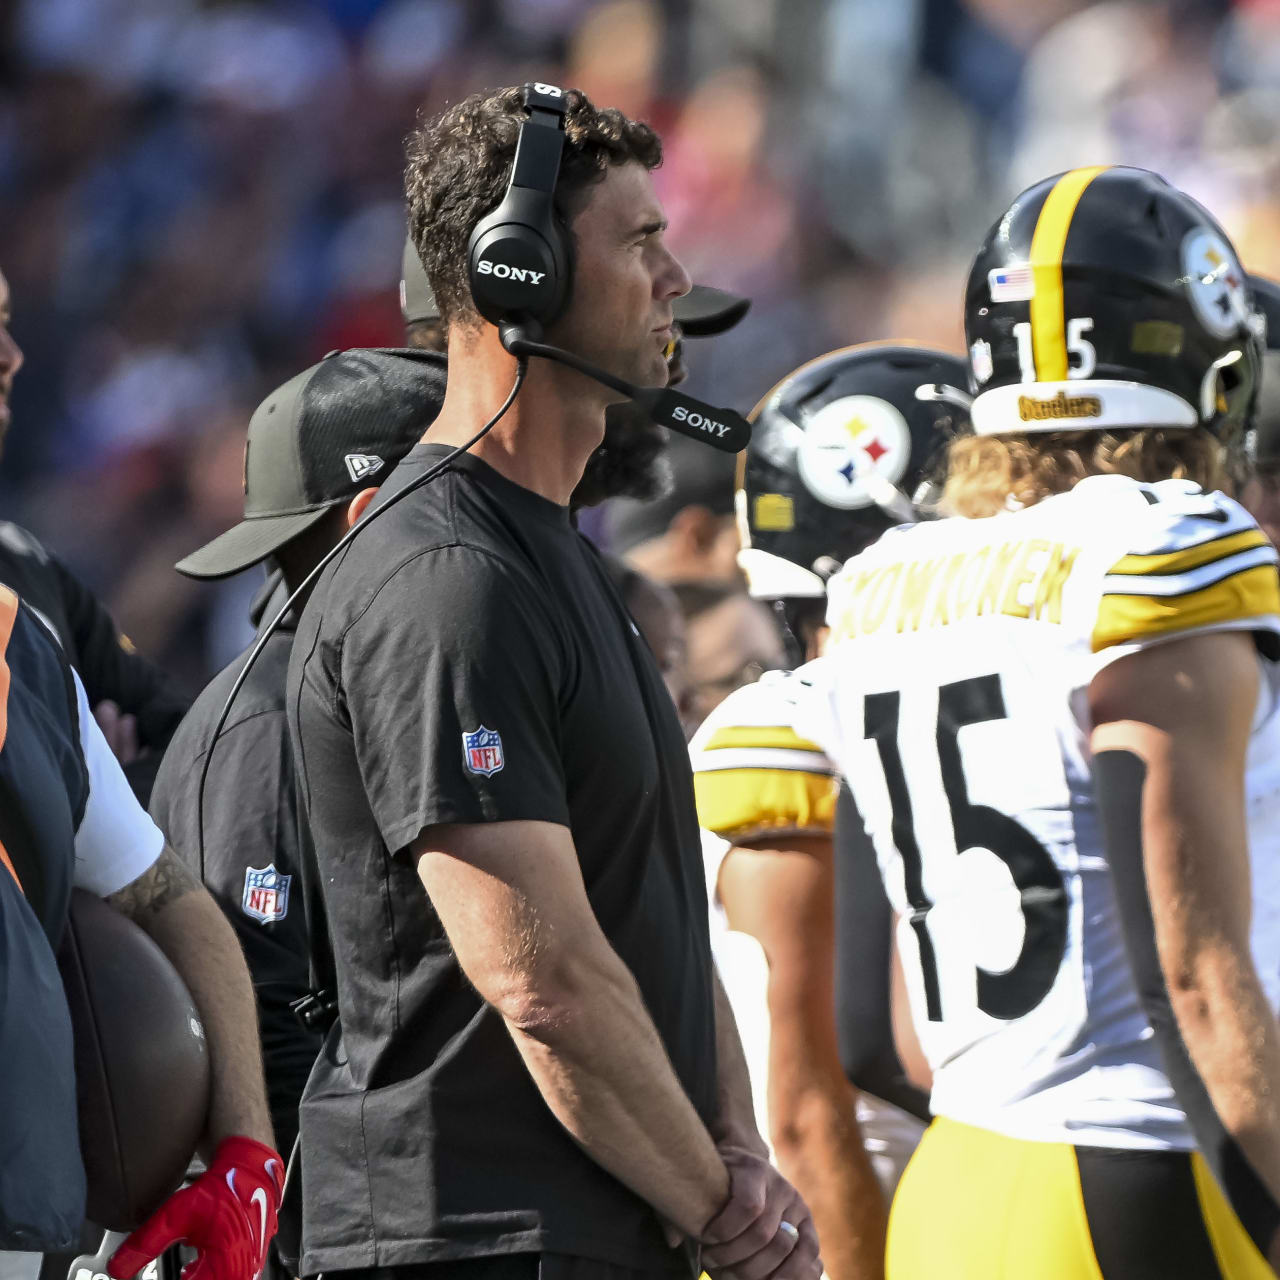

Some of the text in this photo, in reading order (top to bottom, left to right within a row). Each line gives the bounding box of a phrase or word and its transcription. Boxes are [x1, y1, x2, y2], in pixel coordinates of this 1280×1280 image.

[477, 260, 545, 285] SONY
[672, 406, 731, 438] SONY
[470, 747, 502, 770] NFL
[863, 672, 1070, 1022] 15
[249, 888, 283, 914] NFL
